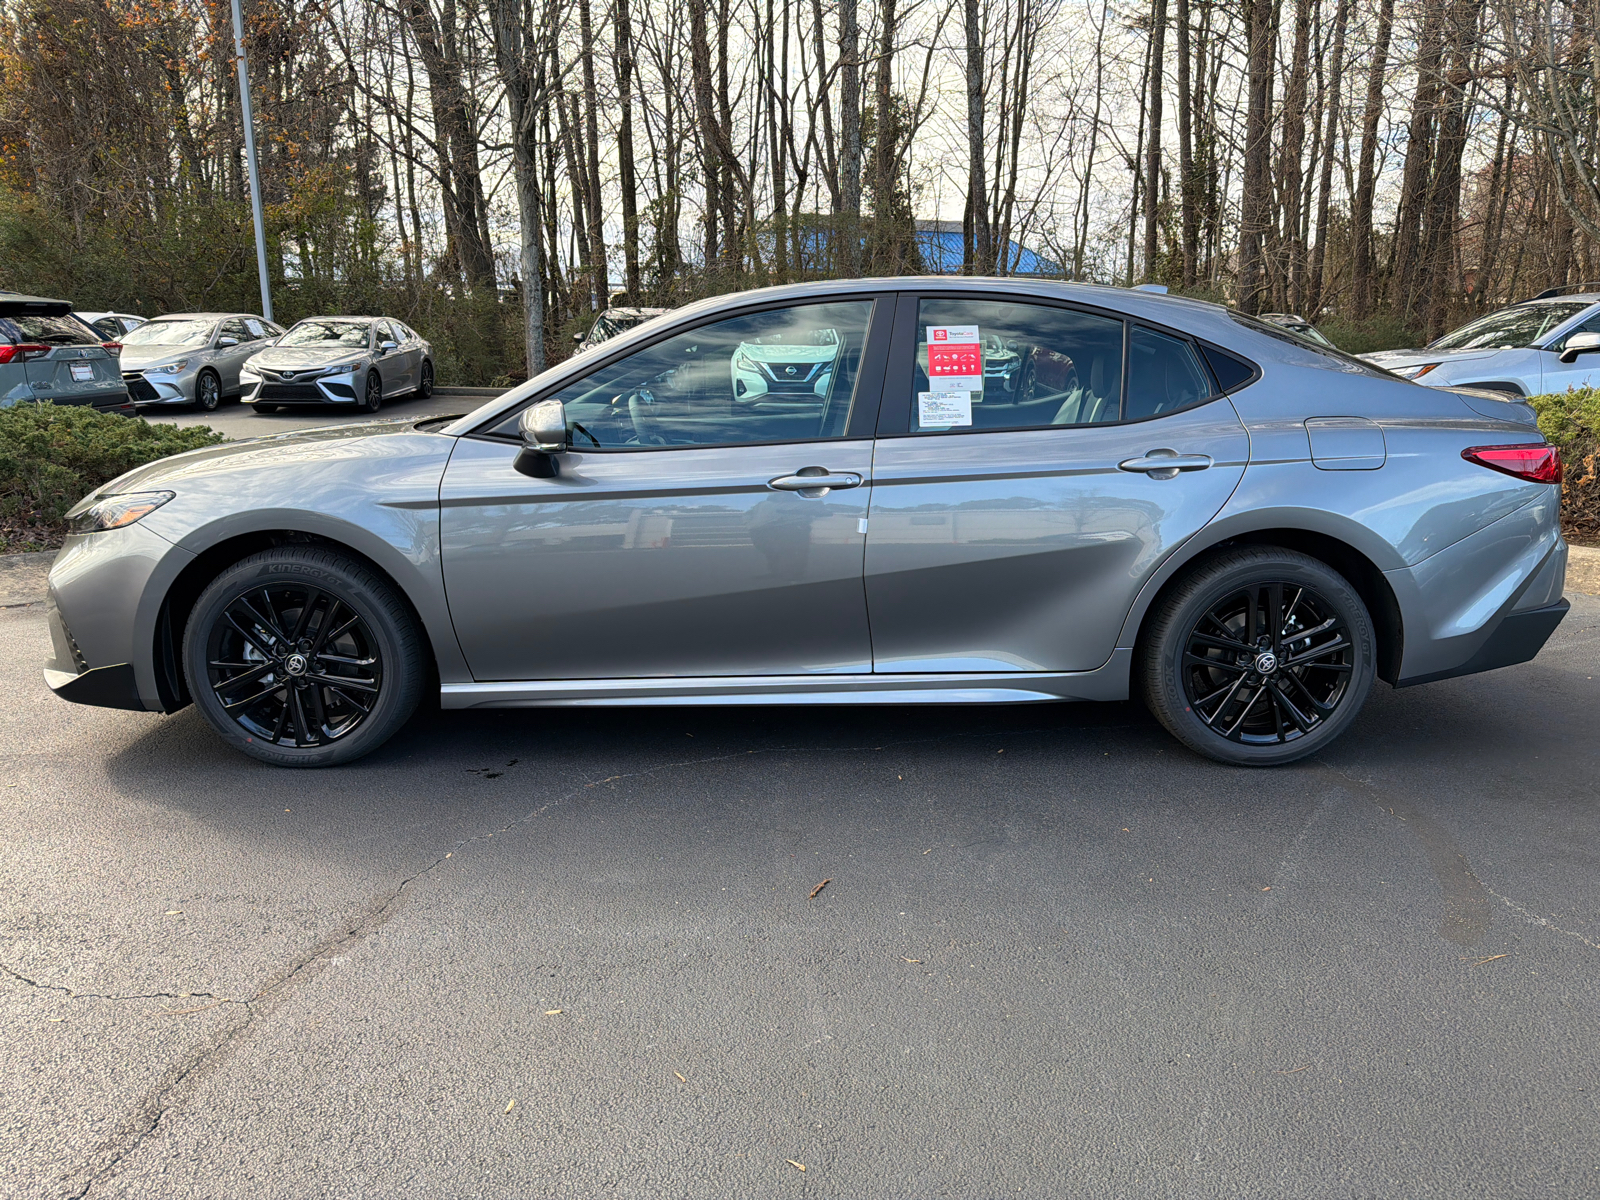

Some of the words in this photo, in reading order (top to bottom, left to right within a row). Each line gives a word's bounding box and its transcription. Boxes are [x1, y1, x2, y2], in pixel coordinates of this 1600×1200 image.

[268, 564, 329, 578] KINERGY
[327, 576, 343, 586] GT
[1362, 642, 1370, 656] GT
